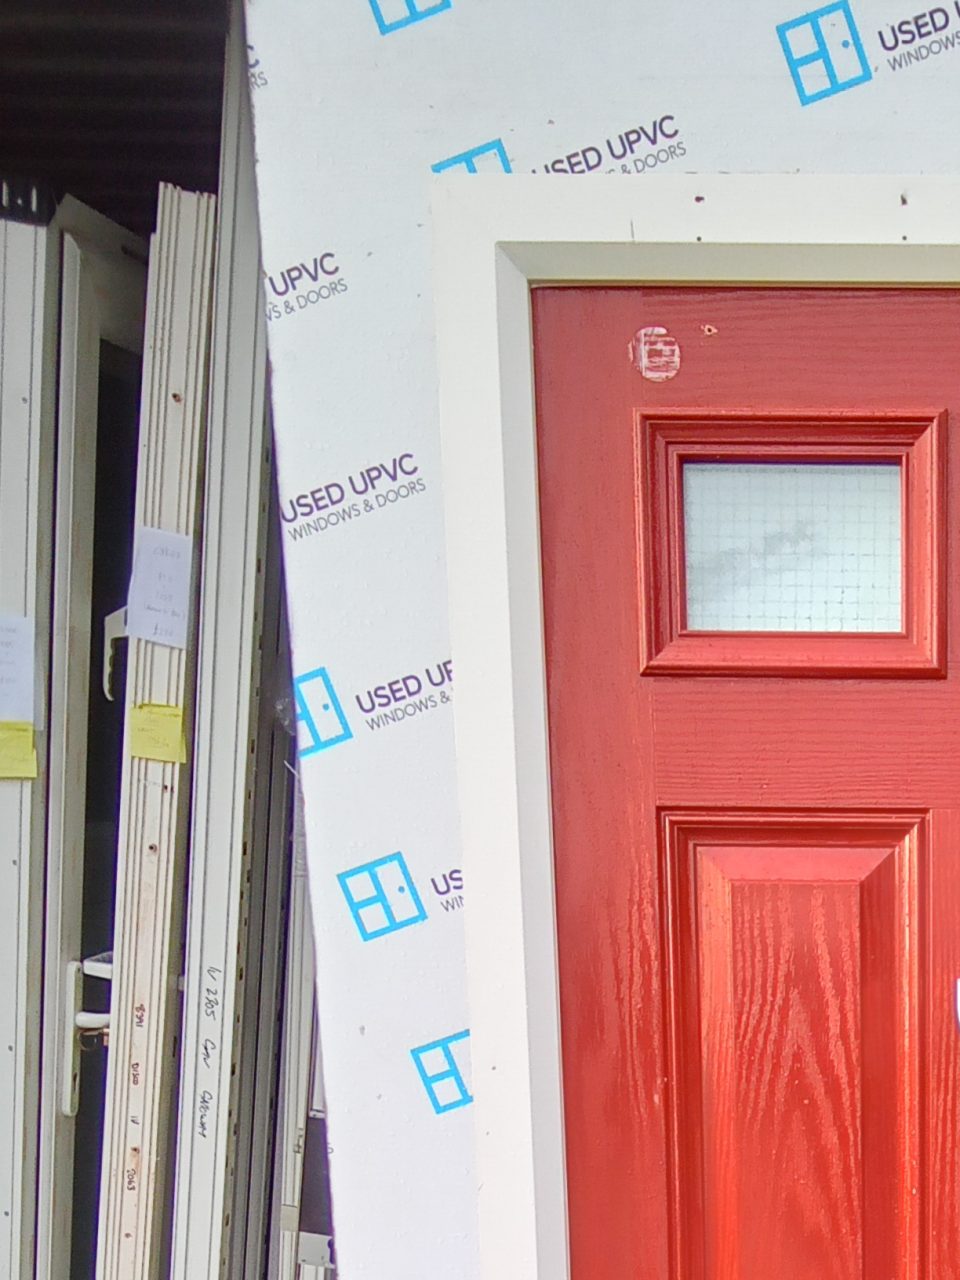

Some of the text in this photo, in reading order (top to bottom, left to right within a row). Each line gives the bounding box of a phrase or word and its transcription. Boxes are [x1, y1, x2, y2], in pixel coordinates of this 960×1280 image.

[878, 7, 950, 51] USED
[531, 115, 679, 173] SED UPVC
[633, 141, 686, 173] DOORS
[268, 252, 339, 297] UPVC
[283, 300, 296, 315] &
[296, 278, 348, 309] DOORS
[280, 453, 419, 523] USED UPVC
[288, 478, 427, 541] WINDOWS & DOORS
[355, 659, 452, 713] USED UP
[365, 690, 451, 731] WINDOWS &
[431, 869, 463, 895] US
